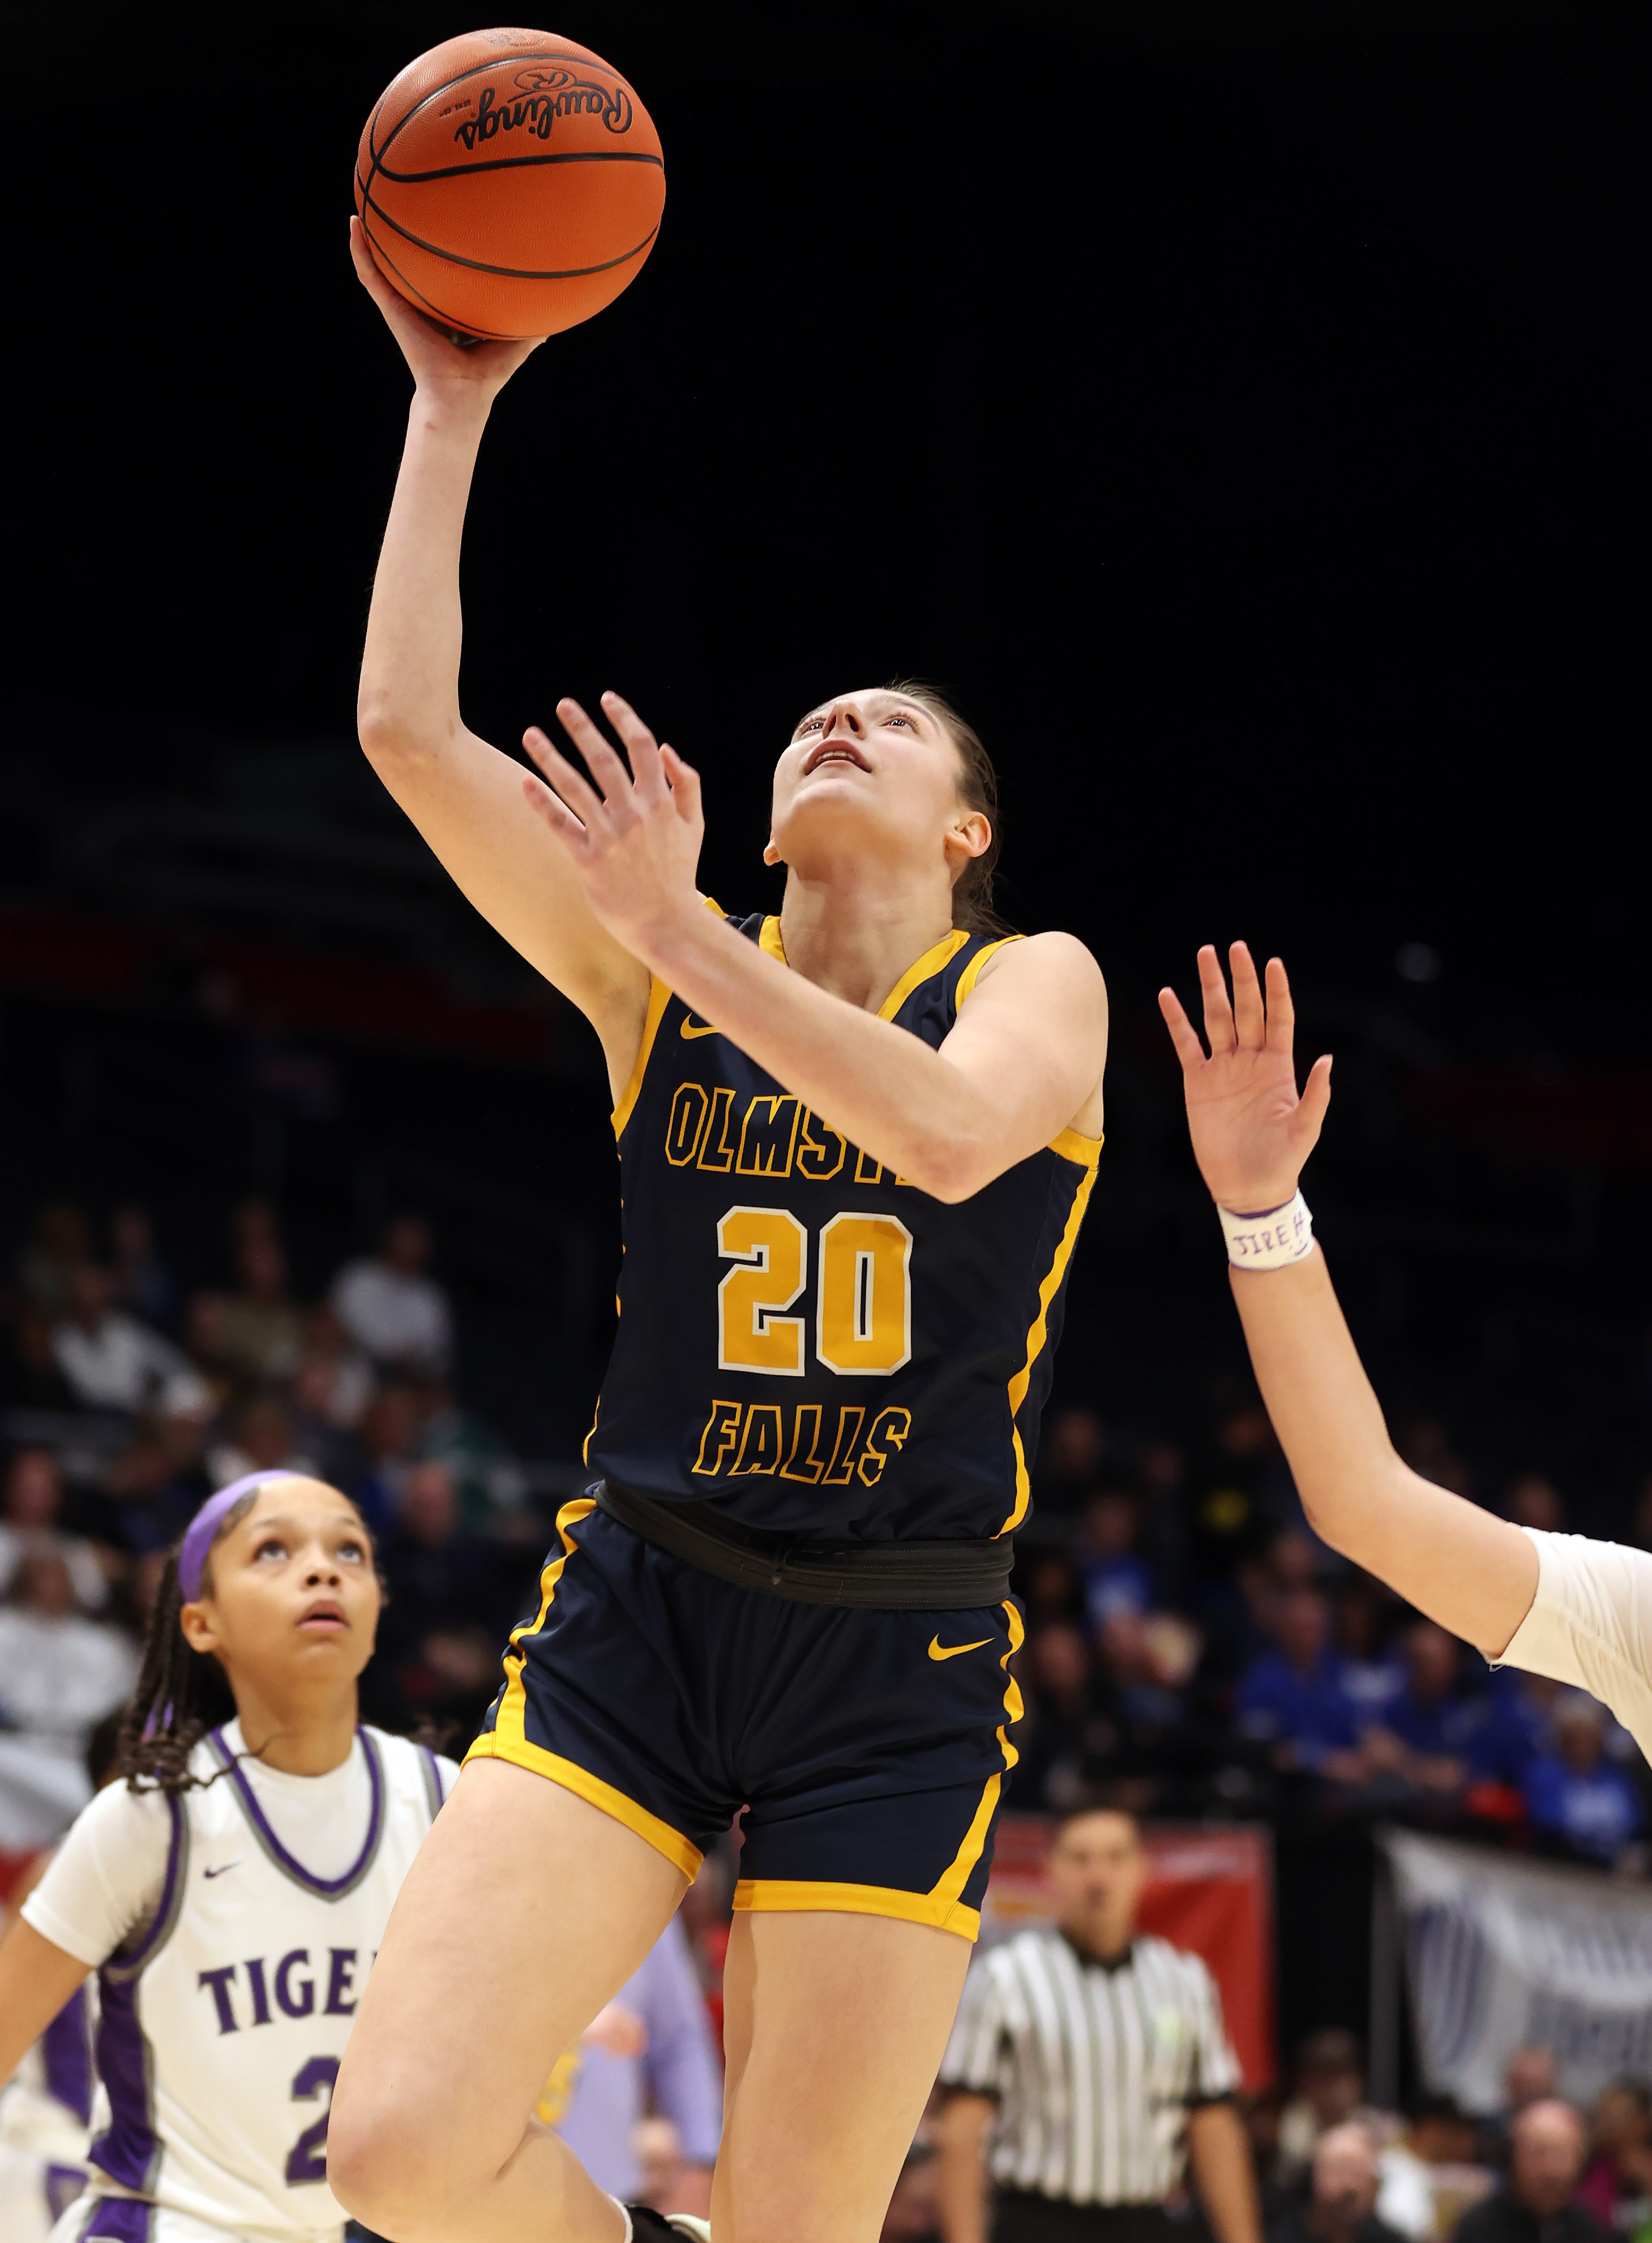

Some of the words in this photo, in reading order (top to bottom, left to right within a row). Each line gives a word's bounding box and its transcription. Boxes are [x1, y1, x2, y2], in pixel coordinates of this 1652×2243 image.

[455, 87, 632, 149] Rawlings
[665, 1082, 915, 1187] OLMS
[716, 1205, 913, 1377] 20
[692, 1399, 912, 1488] FALLS
[199, 1947, 378, 2035] TIGE
